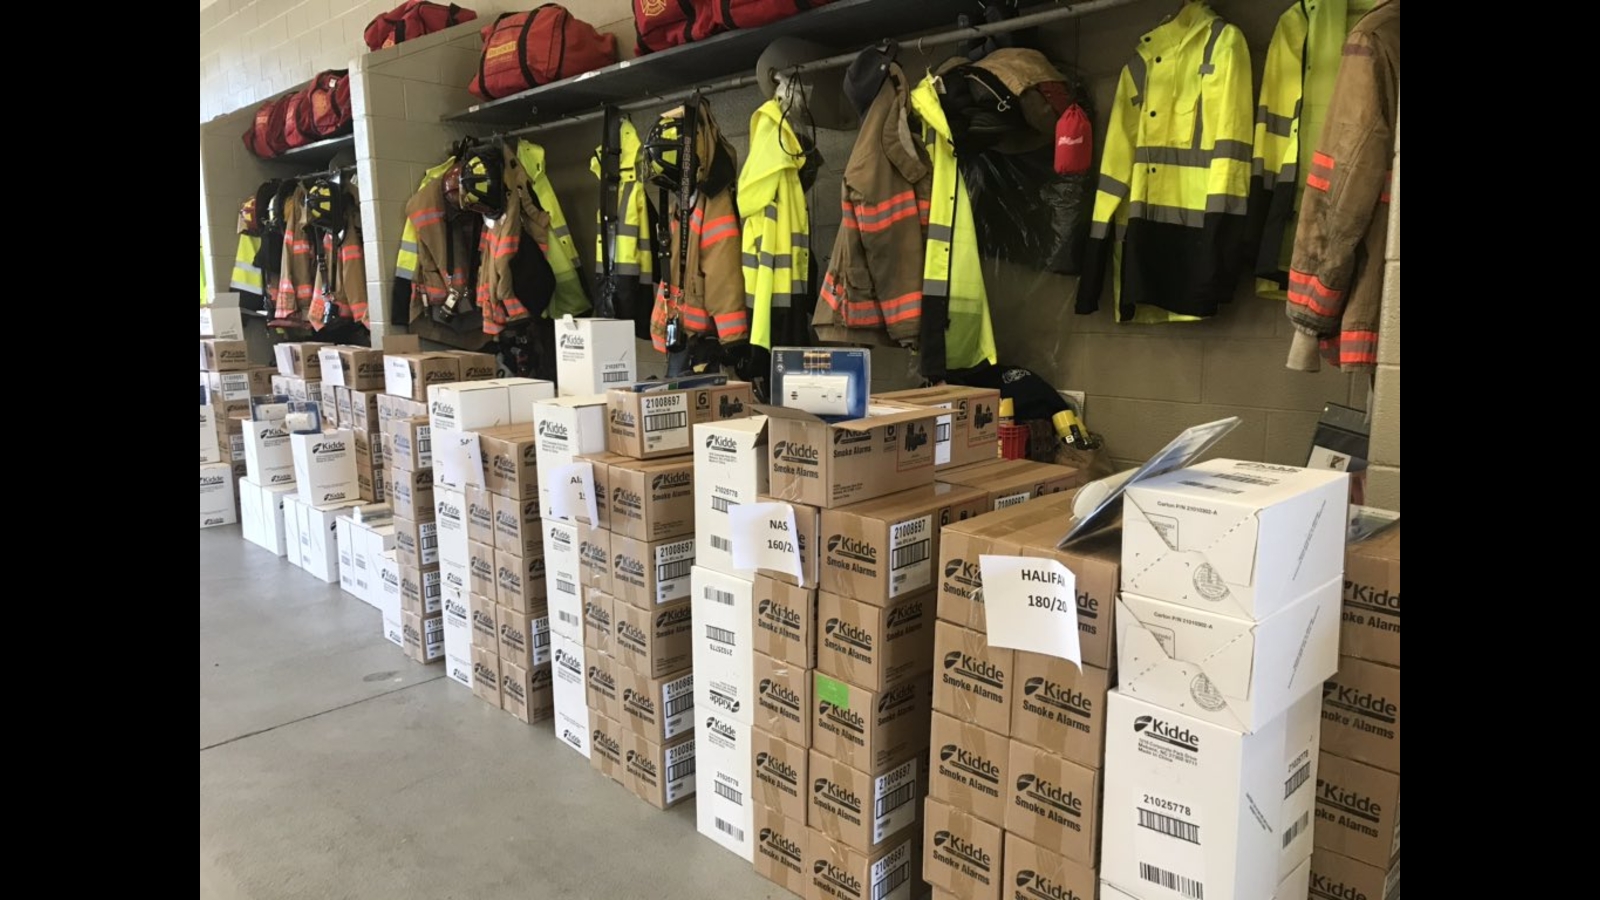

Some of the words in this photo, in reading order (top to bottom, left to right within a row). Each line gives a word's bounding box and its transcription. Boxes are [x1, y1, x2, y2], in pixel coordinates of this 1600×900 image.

[567, 334, 585, 345] Kidde
[437, 403, 454, 416] Kidde
[646, 395, 681, 409] 21008697
[698, 392, 707, 405] 6
[616, 409, 635, 421] Kidde
[546, 421, 568, 436] Kidde
[322, 441, 346, 450] Kidde
[714, 435, 737, 449] Kidde
[786, 441, 819, 460] Kidde
[833, 448, 852, 459] Smoke
[853, 444, 872, 455] Alarms
[663, 471, 691, 484] Kidde
[773, 463, 795, 475] Smoke
[796, 467, 819, 479] Alarms
[620, 488, 642, 504] Kidde
[652, 493, 671, 501] Smoke
[769, 519, 790, 531] NAS
[941, 509, 949, 526] 6
[894, 519, 926, 540] 21008697
[660, 541, 693, 558] 21008697
[841, 536, 877, 558] Kidde
[622, 555, 645, 572] Kidde
[826, 556, 850, 571] Smoke
[851, 563, 877, 578] Alarms
[1352, 583, 1400, 609] Kidd
[591, 603, 610, 621] Kidde
[668, 605, 691, 620] Kidd
[770, 600, 800, 624] Kidde
[899, 601, 923, 617] Kidde
[625, 622, 647, 641] Kidde
[758, 618, 778, 634] Smoke
[838, 621, 872, 645] Kidde
[1342, 611, 1364, 625] oke
[1367, 616, 1400, 634] Alarm
[562, 651, 582, 668] Kidde
[824, 638, 846, 654] Smoke
[848, 648, 872, 665] Alarms
[596, 669, 615, 686] Kidde
[962, 653, 1004, 683] Kidde
[631, 690, 655, 709] Kidde
[770, 680, 800, 705] Kidde
[943, 673, 971, 692] Smoke
[973, 684, 1004, 704] Alarms
[1044, 680, 1092, 711] Kidde
[710, 693, 732, 711] Kidde
[759, 697, 778, 713] Smoke
[780, 707, 801, 723] Alarms
[1336, 686, 1397, 716] Kidde
[832, 703, 865, 728] Kidde
[1023, 699, 1054, 720] Smoke
[1056, 711, 1091, 734] Alarms
[714, 719, 736, 737] Kidde
[818, 718, 841, 736] Smoke
[841, 729, 864, 747] Alarms
[1152, 718, 1199, 746] Kidde
[1353, 715, 1394, 740] Alarms
[600, 731, 620, 751] Kidde
[634, 753, 657, 773] Kidde
[768, 754, 798, 780] Kidde
[957, 747, 1000, 778] Kidde
[756, 769, 776, 786] Smoke
[776, 780, 798, 798] Alarms
[939, 765, 967, 785] Smoke
[969, 777, 999, 798] Alarms
[827, 781, 861, 808] Kidde
[1035, 777, 1082, 811] Kidde
[1143, 794, 1192, 816] 21025778
[1324, 783, 1381, 817] Kidde
[813, 796, 836, 815] Smoke
[837, 807, 861, 826] Alarms
[1015, 795, 1046, 817] Smoke
[1048, 809, 1081, 832] Alarms
[1315, 808, 1335, 823] oke
[1338, 815, 1379, 838] Alarms
[771, 830, 802, 857] Kidde
[949, 834, 991, 866] Kidde
[759, 844, 779, 861] Smoke
[780, 857, 802, 874] Alarms
[932, 850, 960, 871] Smoke
[962, 864, 990, 886] Alarms
[812, 877, 836, 896] Smoke
[827, 863, 861, 892] Kidde
